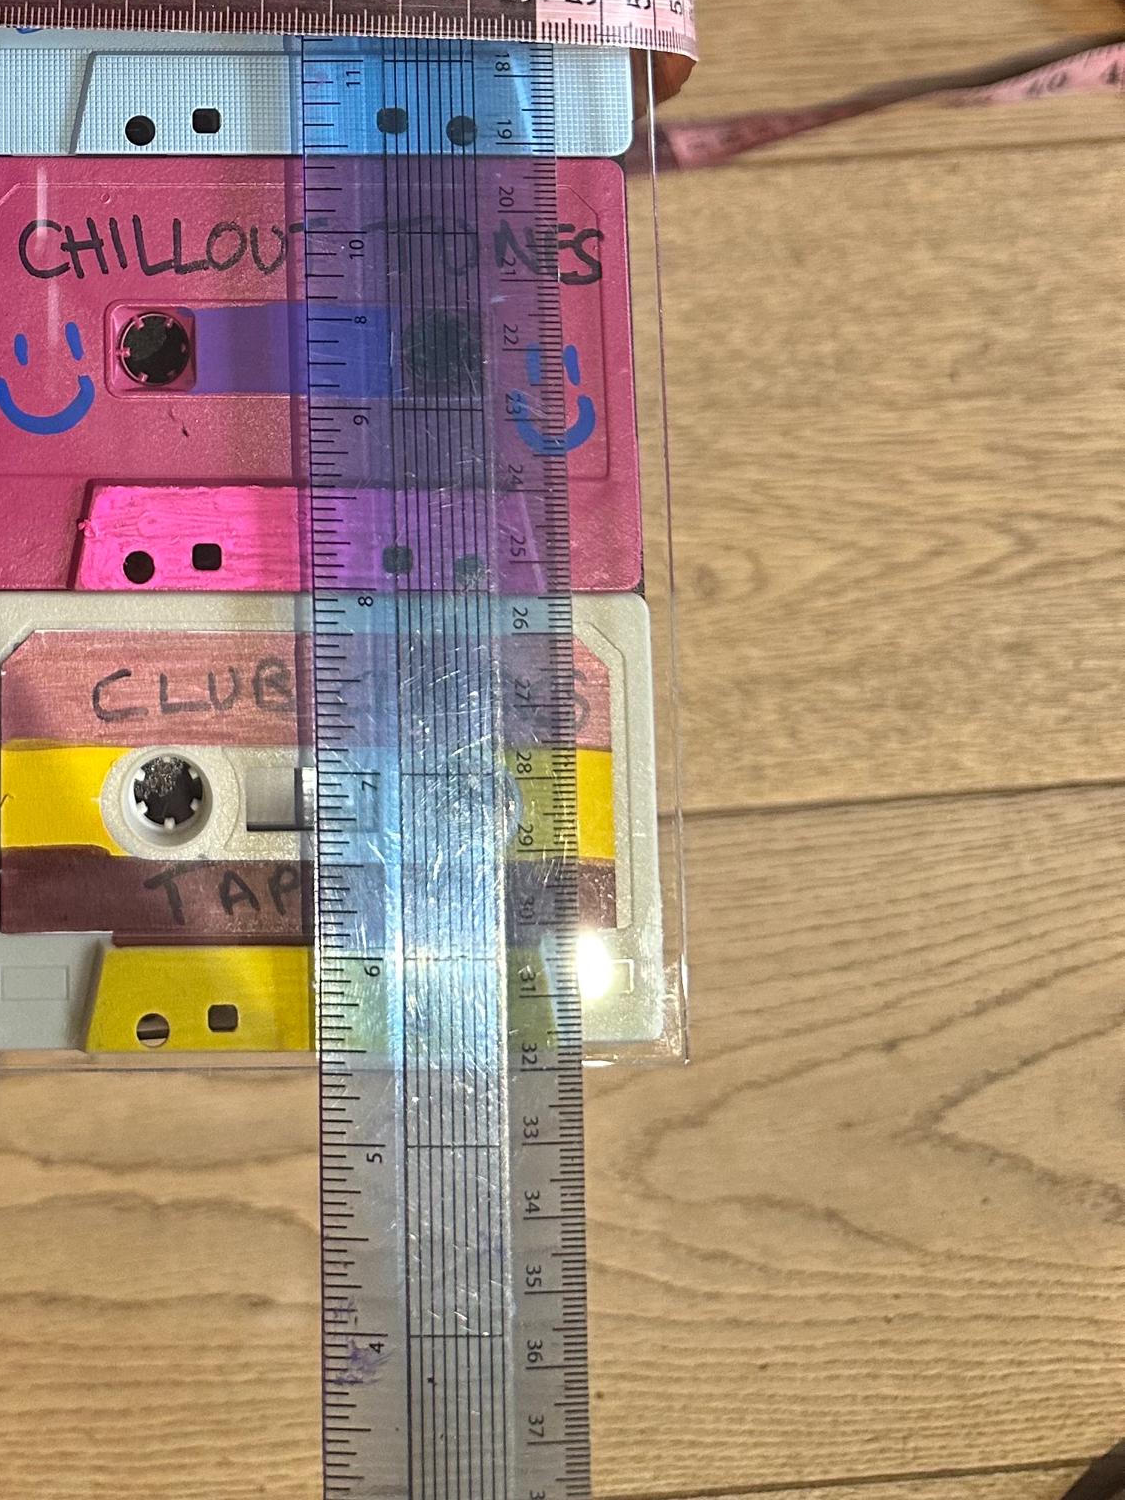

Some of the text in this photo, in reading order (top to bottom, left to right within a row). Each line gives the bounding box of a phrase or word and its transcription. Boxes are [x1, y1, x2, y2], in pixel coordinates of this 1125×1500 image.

[495, 51, 511, 72] 18
[346, 70, 361, 88] 11
[497, 119, 512, 139] 19
[499, 185, 514, 208] 20
[349, 239, 364, 260] 10
[504, 323, 518, 345] 22
[508, 464, 523, 486] 24
[510, 535, 525, 557] 25
[357, 596, 373, 607] 8
[513, 606, 529, 629] 26
[91, 656, 299, 723] CLUB
[514, 678, 531, 702] 27
[516, 750, 532, 774] 28
[518, 823, 534, 847] 29
[521, 1042, 538, 1065] 32
[523, 1115, 539, 1139] 33
[366, 1152, 382, 1164] 5
[524, 1190, 540, 1214] 34
[525, 1264, 542, 1288] 35
[369, 1342, 384, 1354] 4
[526, 1339, 543, 1363] 36
[528, 1414, 544, 1438] 37
[530, 1489, 546, 1500] 3
